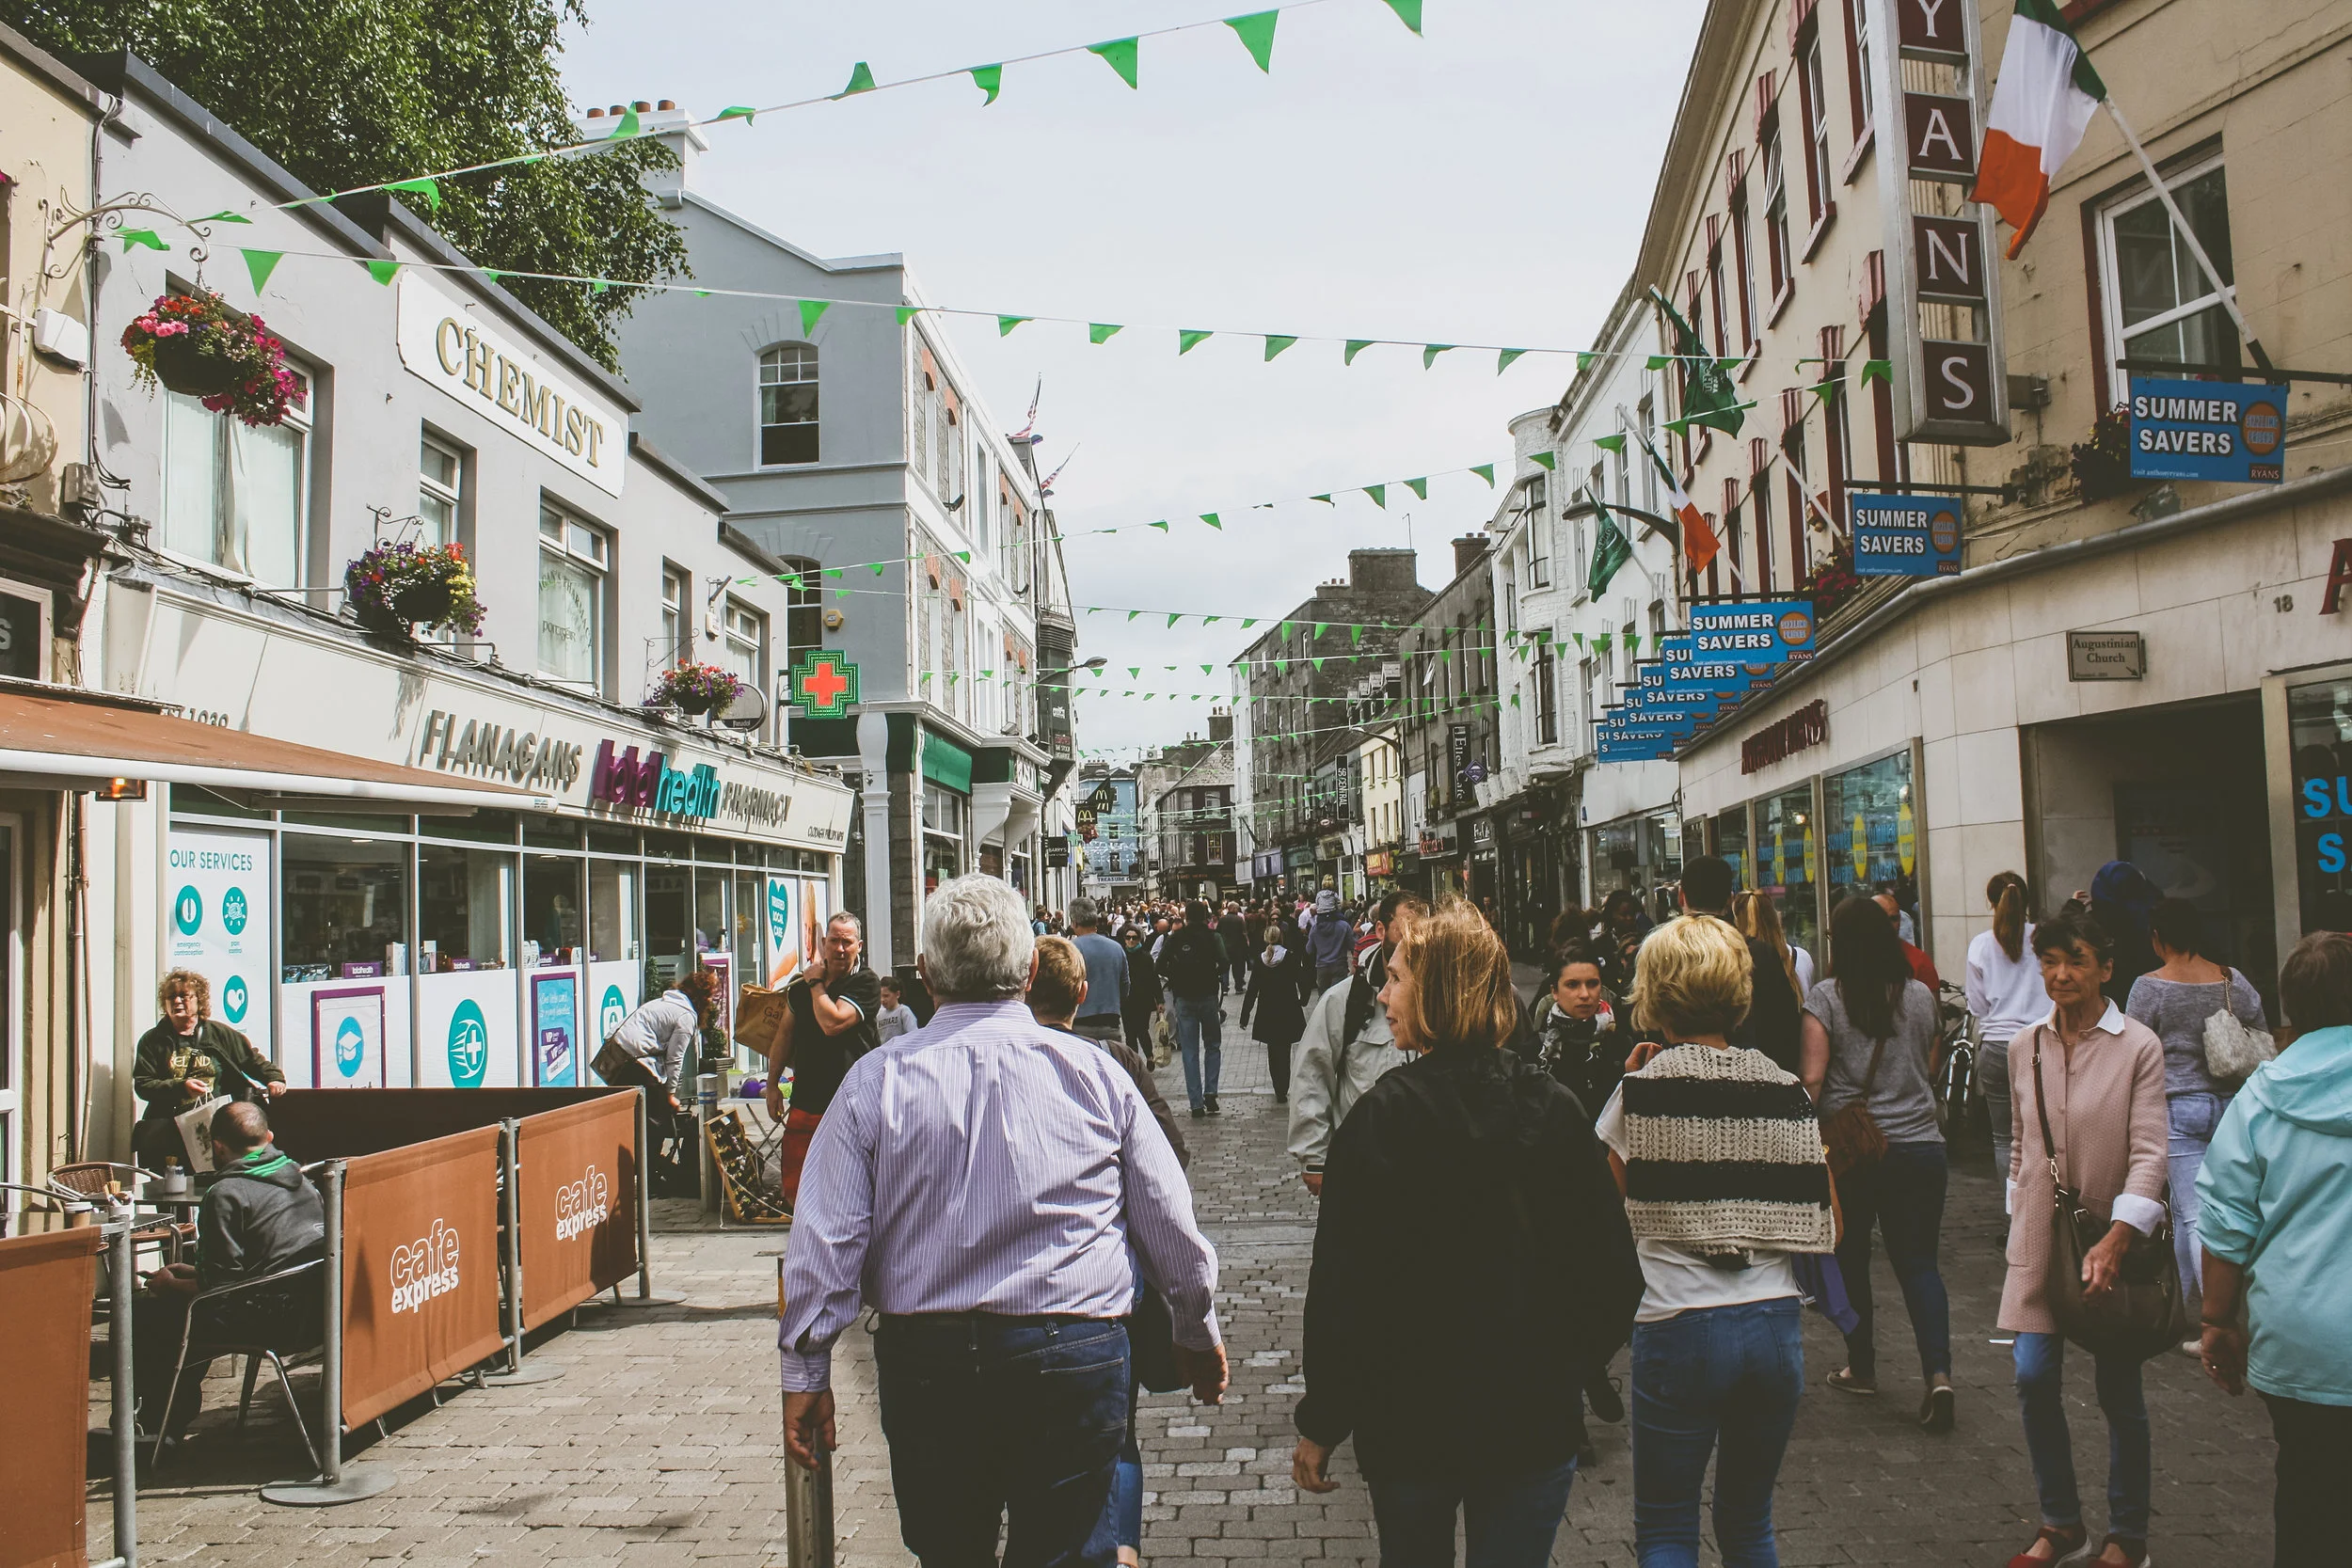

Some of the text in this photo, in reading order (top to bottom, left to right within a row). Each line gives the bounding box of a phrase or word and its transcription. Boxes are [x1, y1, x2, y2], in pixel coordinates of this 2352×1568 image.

[436, 317, 604, 468] CHEMIST
[2134, 396, 2237, 422] SUMMER
[2138, 429, 2232, 454] SAVERS
[2250, 469, 2280, 480] RYANS
[1855, 509, 1928, 528] SUMMER
[1860, 535, 1924, 554] SAVERS
[2273, 594, 2294, 613] 18
[1692, 614, 1774, 631] SUMMER
[1697, 634, 1772, 650] SAVERS
[2073, 638, 2137, 652] Augustinian
[2087, 652, 2125, 662] Church
[1670, 665, 1736, 679] SAVERS
[1454, 737, 1467, 767] Elles
[421, 709, 792, 829] FLANAGANS totalhealth PHARMACY
[1338, 768, 1348, 807] 56 CENTRAL
[170, 849, 253, 871] OUR SERVICES
[555, 1164, 607, 1222] cafe
[556, 1204, 607, 1241] express
[390, 1218, 459, 1289] cafe
[391, 1266, 459, 1313] express
